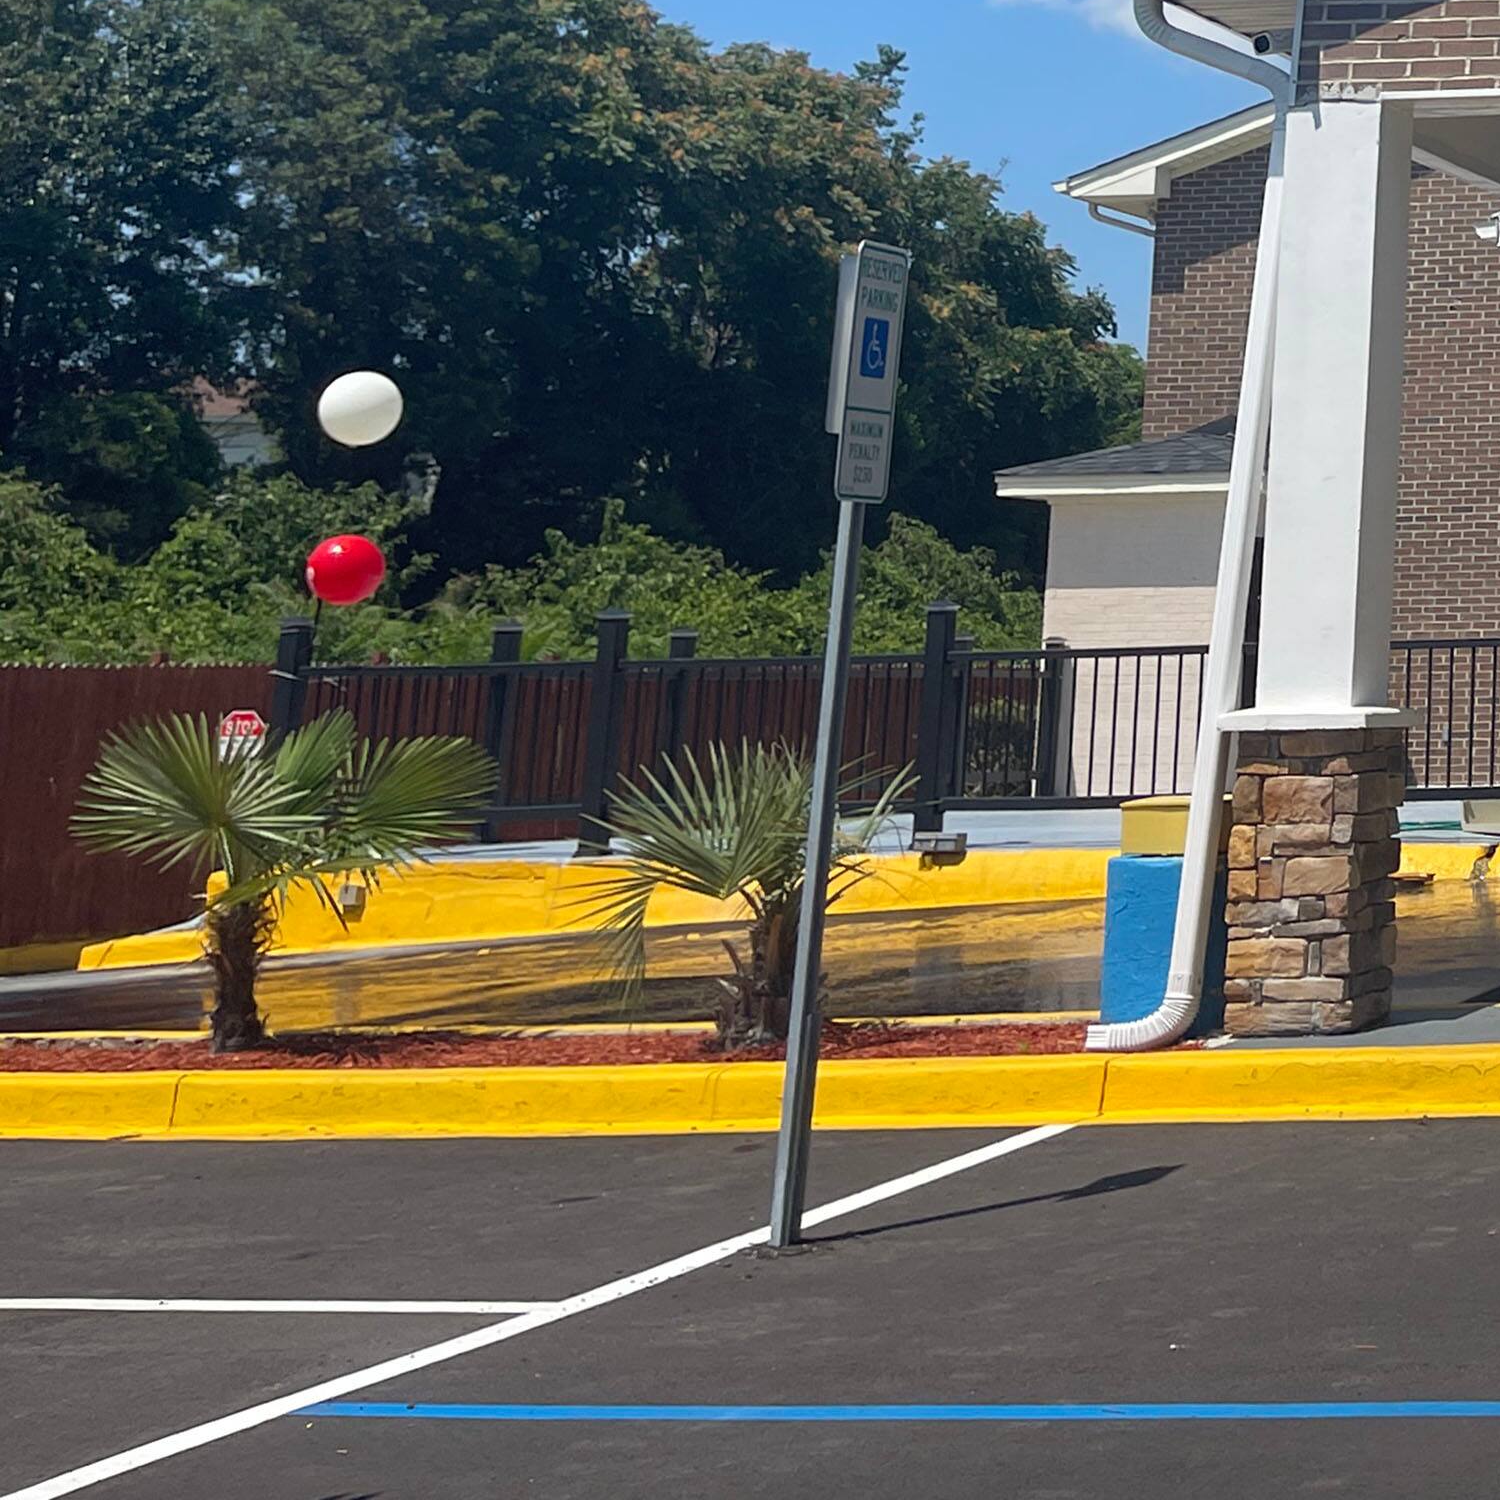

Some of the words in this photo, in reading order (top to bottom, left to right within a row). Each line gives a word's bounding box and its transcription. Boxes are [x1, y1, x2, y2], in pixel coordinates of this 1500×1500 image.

[862, 256, 904, 284] RESERVED
[860, 285, 899, 313] PARKING
[850, 420, 883, 438] MAXIMUM
[849, 442, 880, 461] PENALTY
[224, 718, 259, 736] STOP
